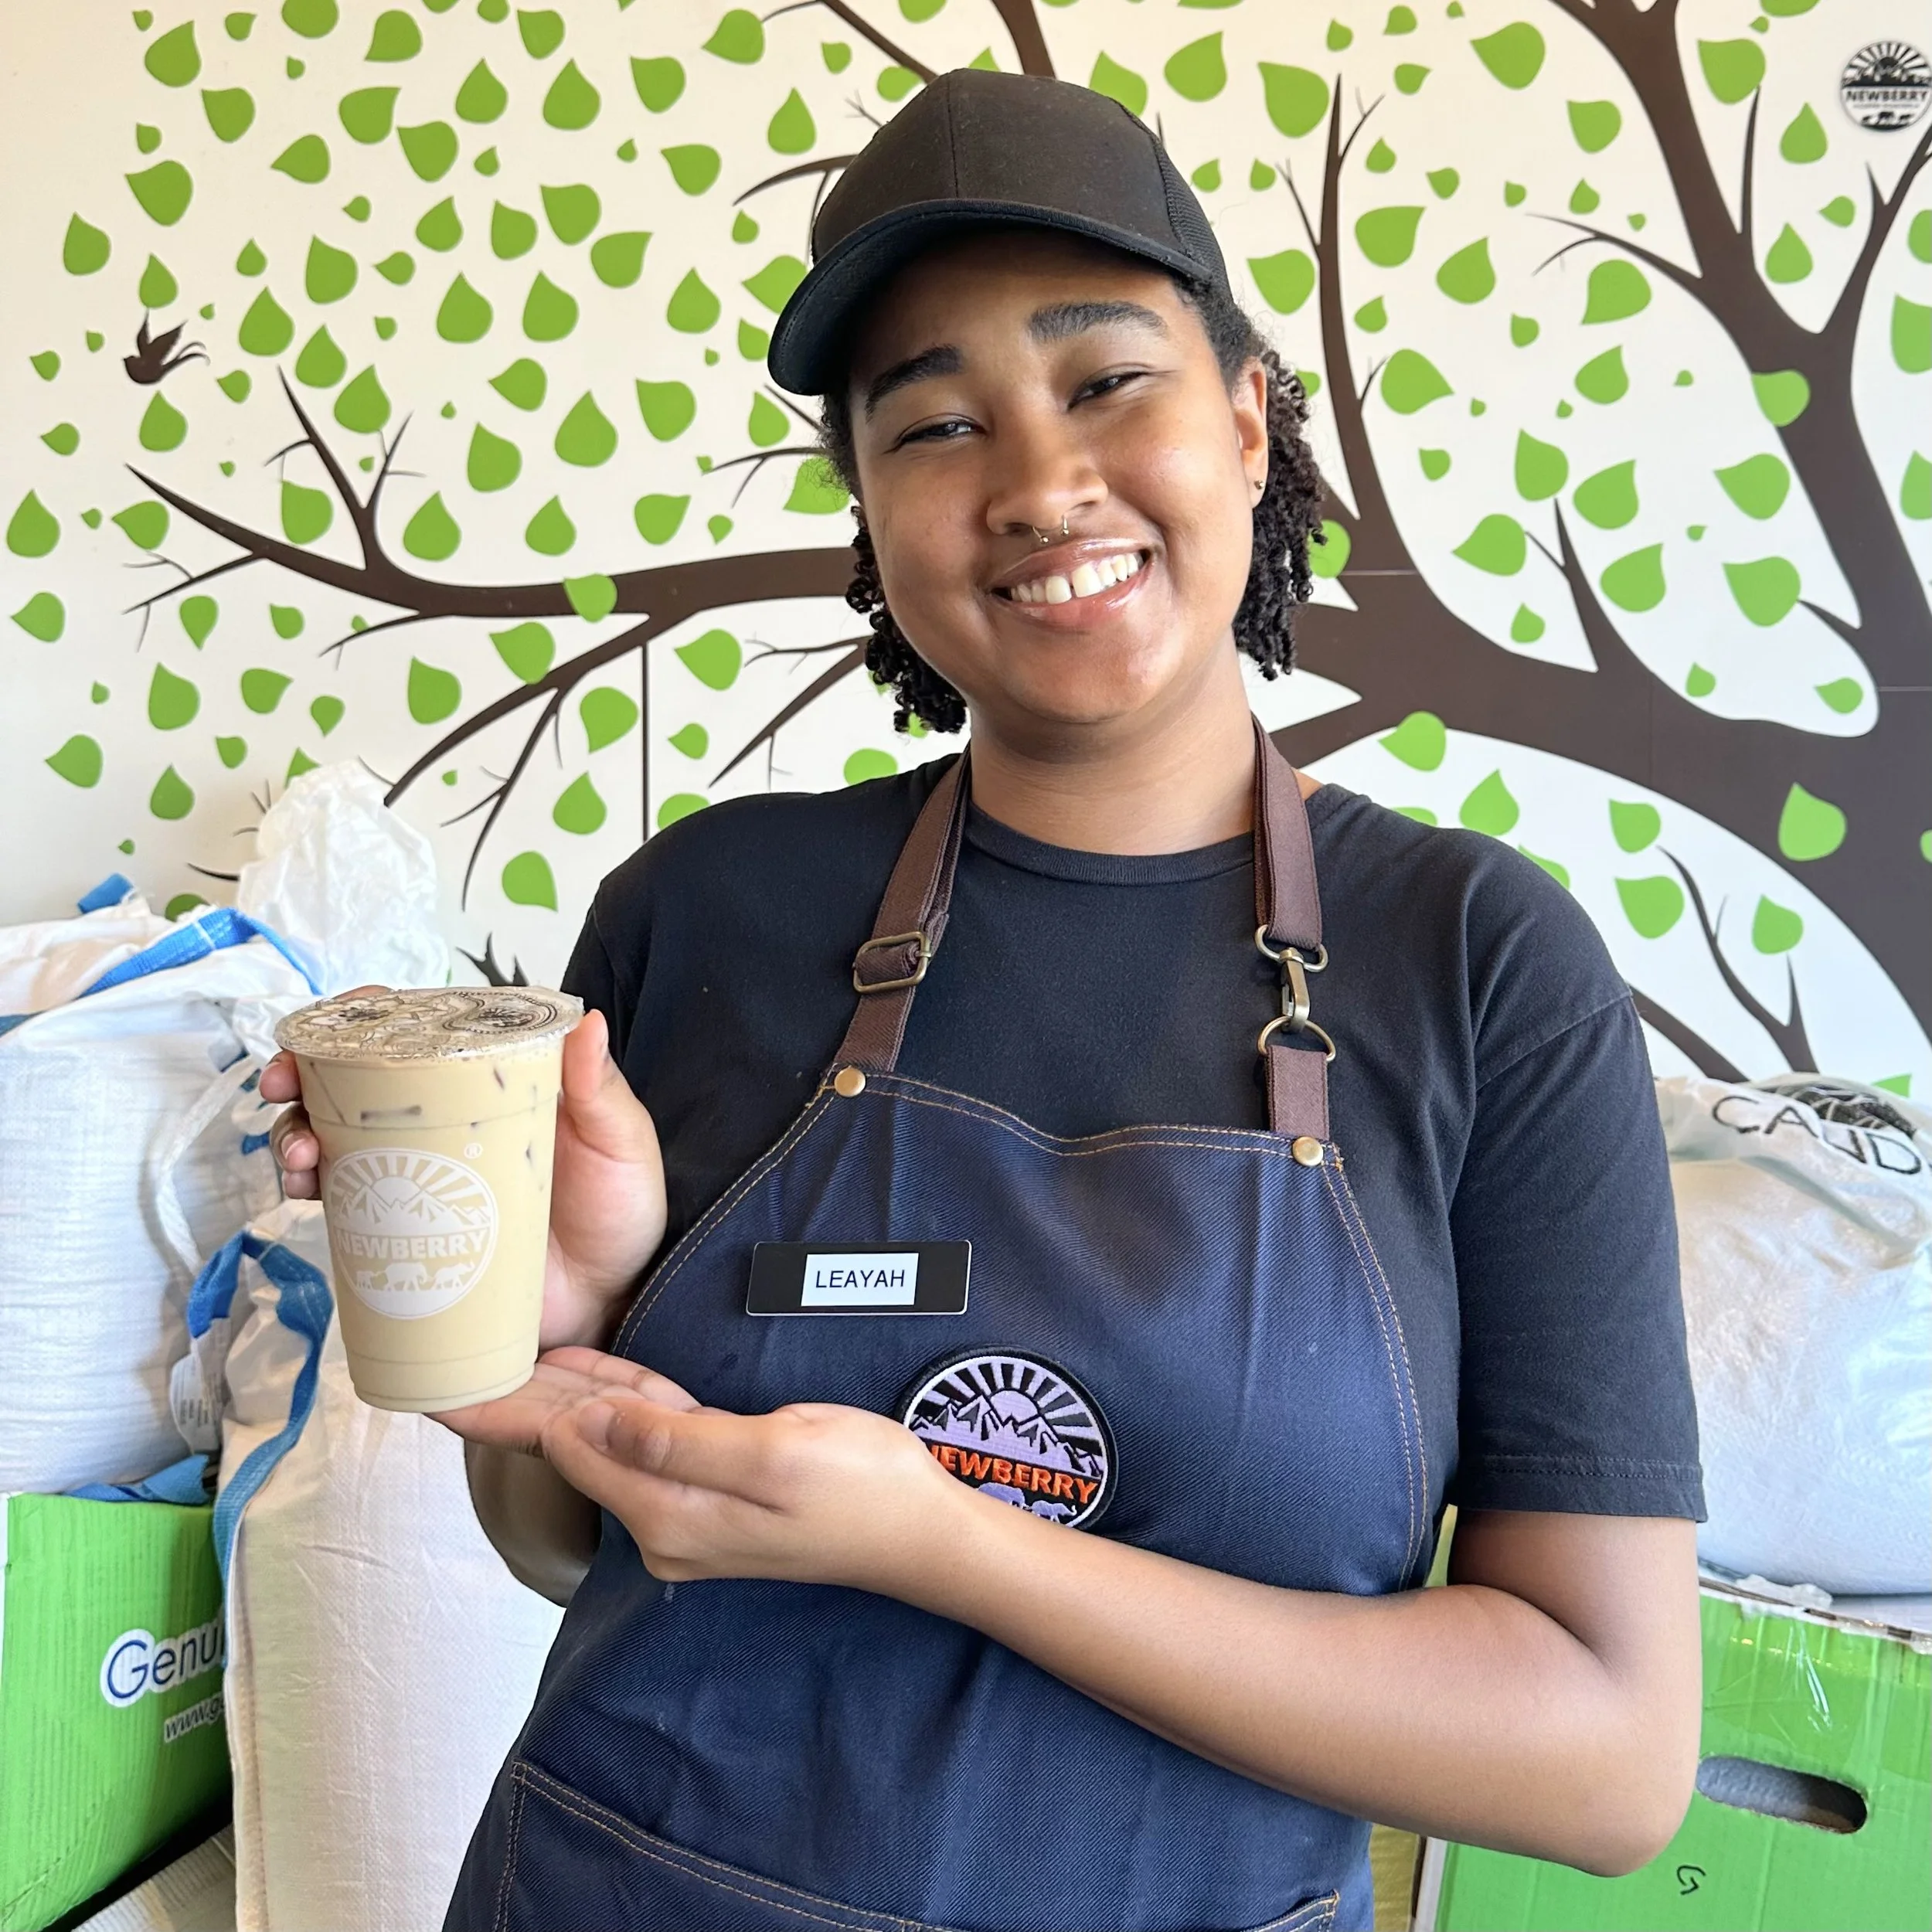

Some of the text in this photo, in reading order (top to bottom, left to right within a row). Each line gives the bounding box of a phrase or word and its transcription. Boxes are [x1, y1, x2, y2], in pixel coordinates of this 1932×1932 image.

[1845, 90, 1929, 101] NEWBERRY
[335, 1228, 489, 1260] NEWBERRY
[815, 1270, 905, 1288] LEAYAH
